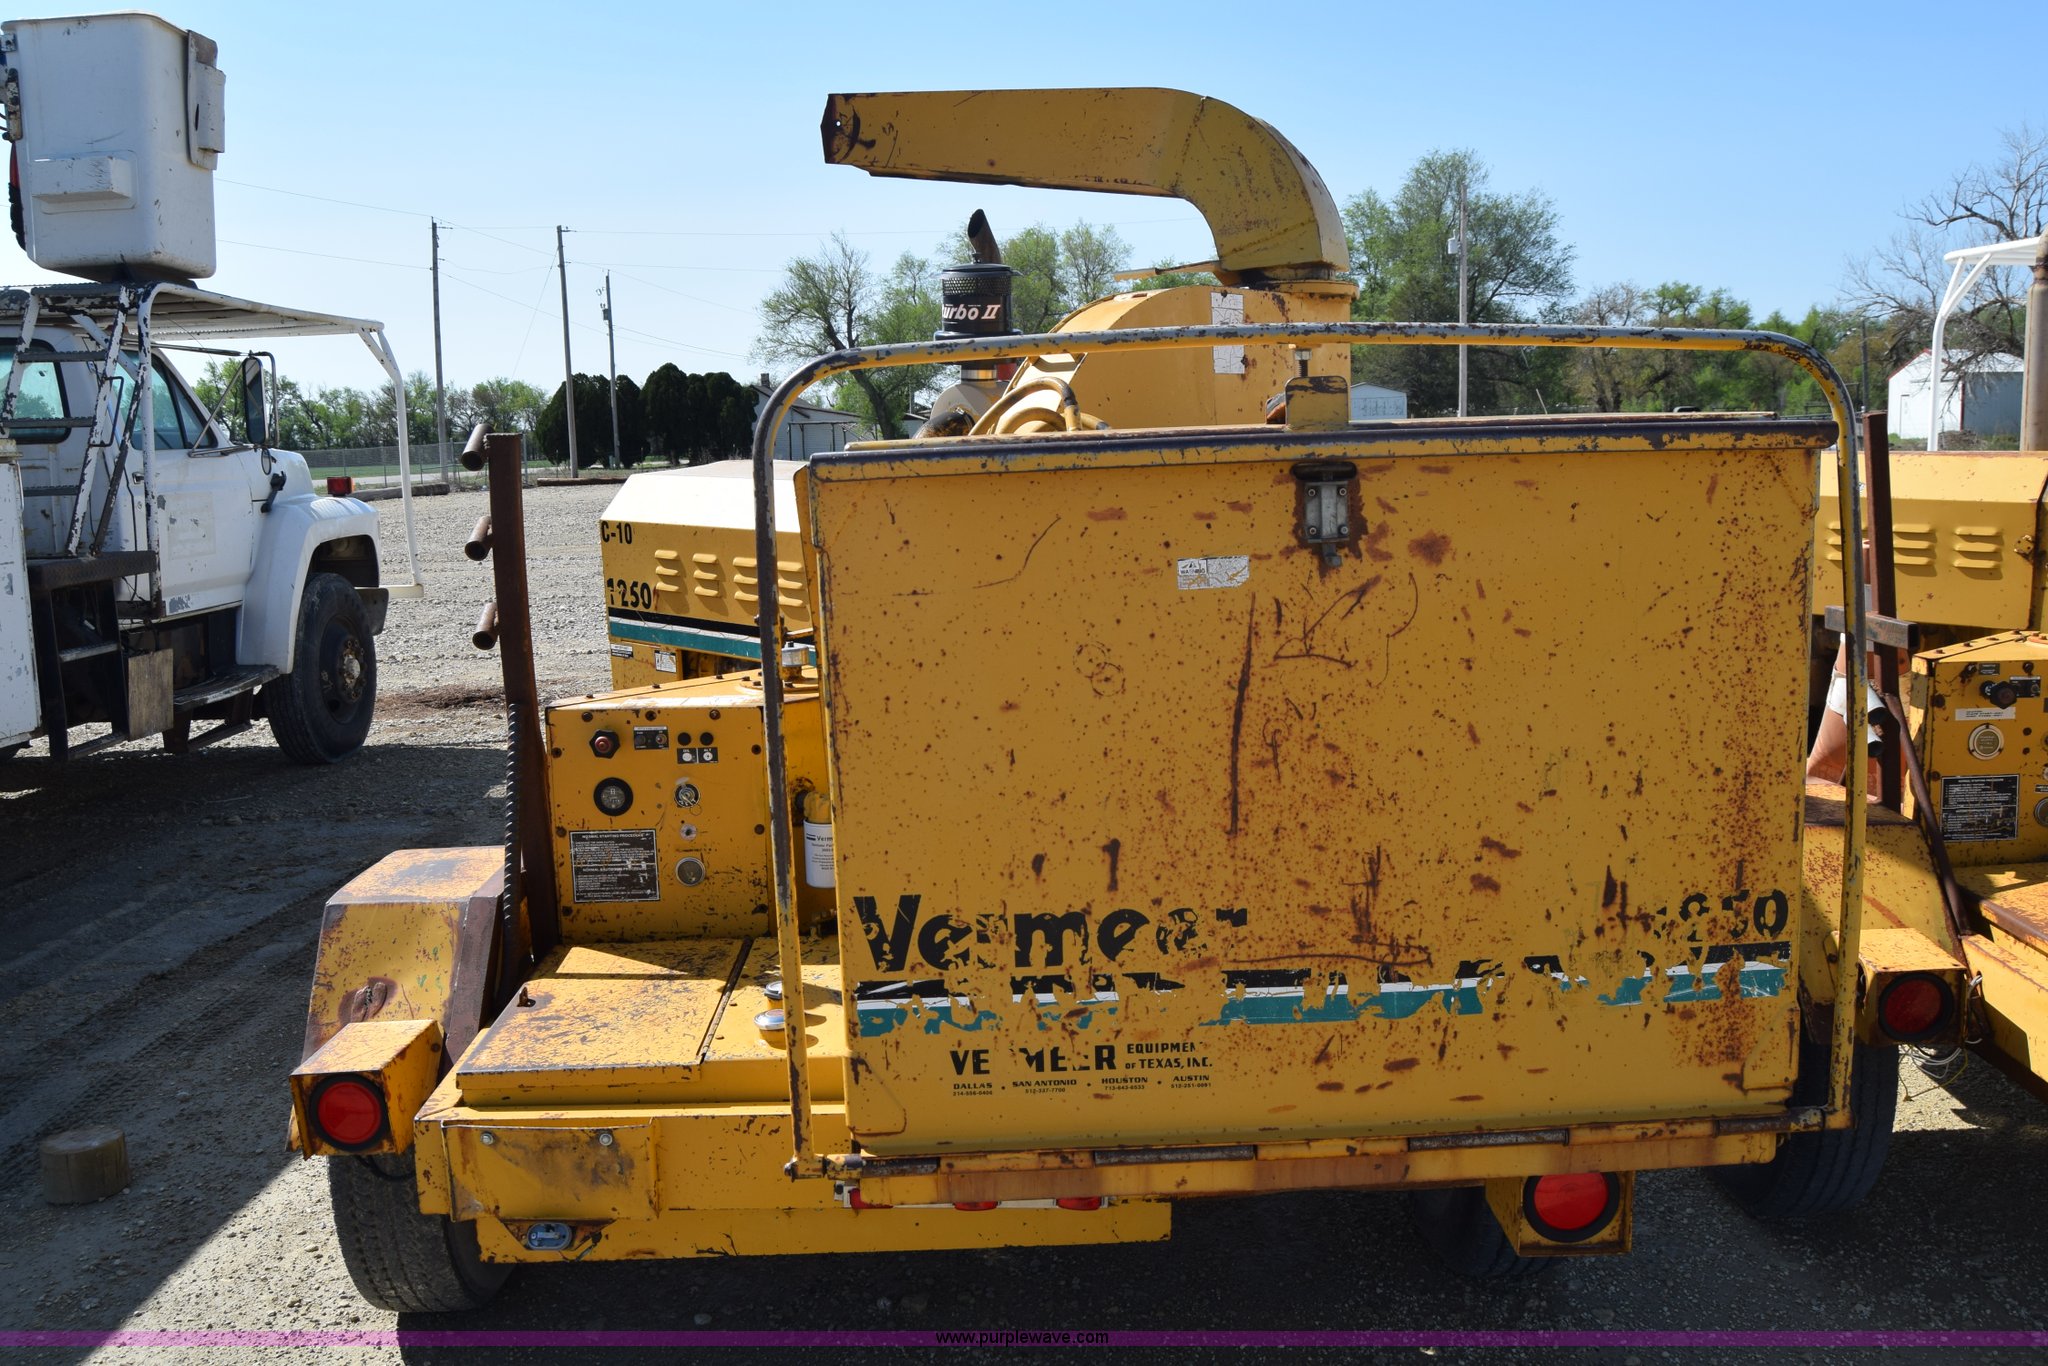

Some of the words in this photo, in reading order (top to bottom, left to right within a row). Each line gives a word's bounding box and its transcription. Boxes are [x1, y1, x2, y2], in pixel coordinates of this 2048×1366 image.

[601, 521, 633, 544] C-10
[607, 578, 652, 609] 1250
[950, 1044, 1117, 1075] VEMER
[1138, 1058, 1185, 1070] TEXAS,
[1187, 1056, 1213, 1068] INC.
[953, 1082, 993, 1090] DALLAS
[1012, 1080, 1032, 1088] SAN
[1034, 1079, 1077, 1087] ANTONIO
[1101, 1076, 1148, 1085] HOUSTON
[1172, 1074, 1210, 1083] AUSTIN
